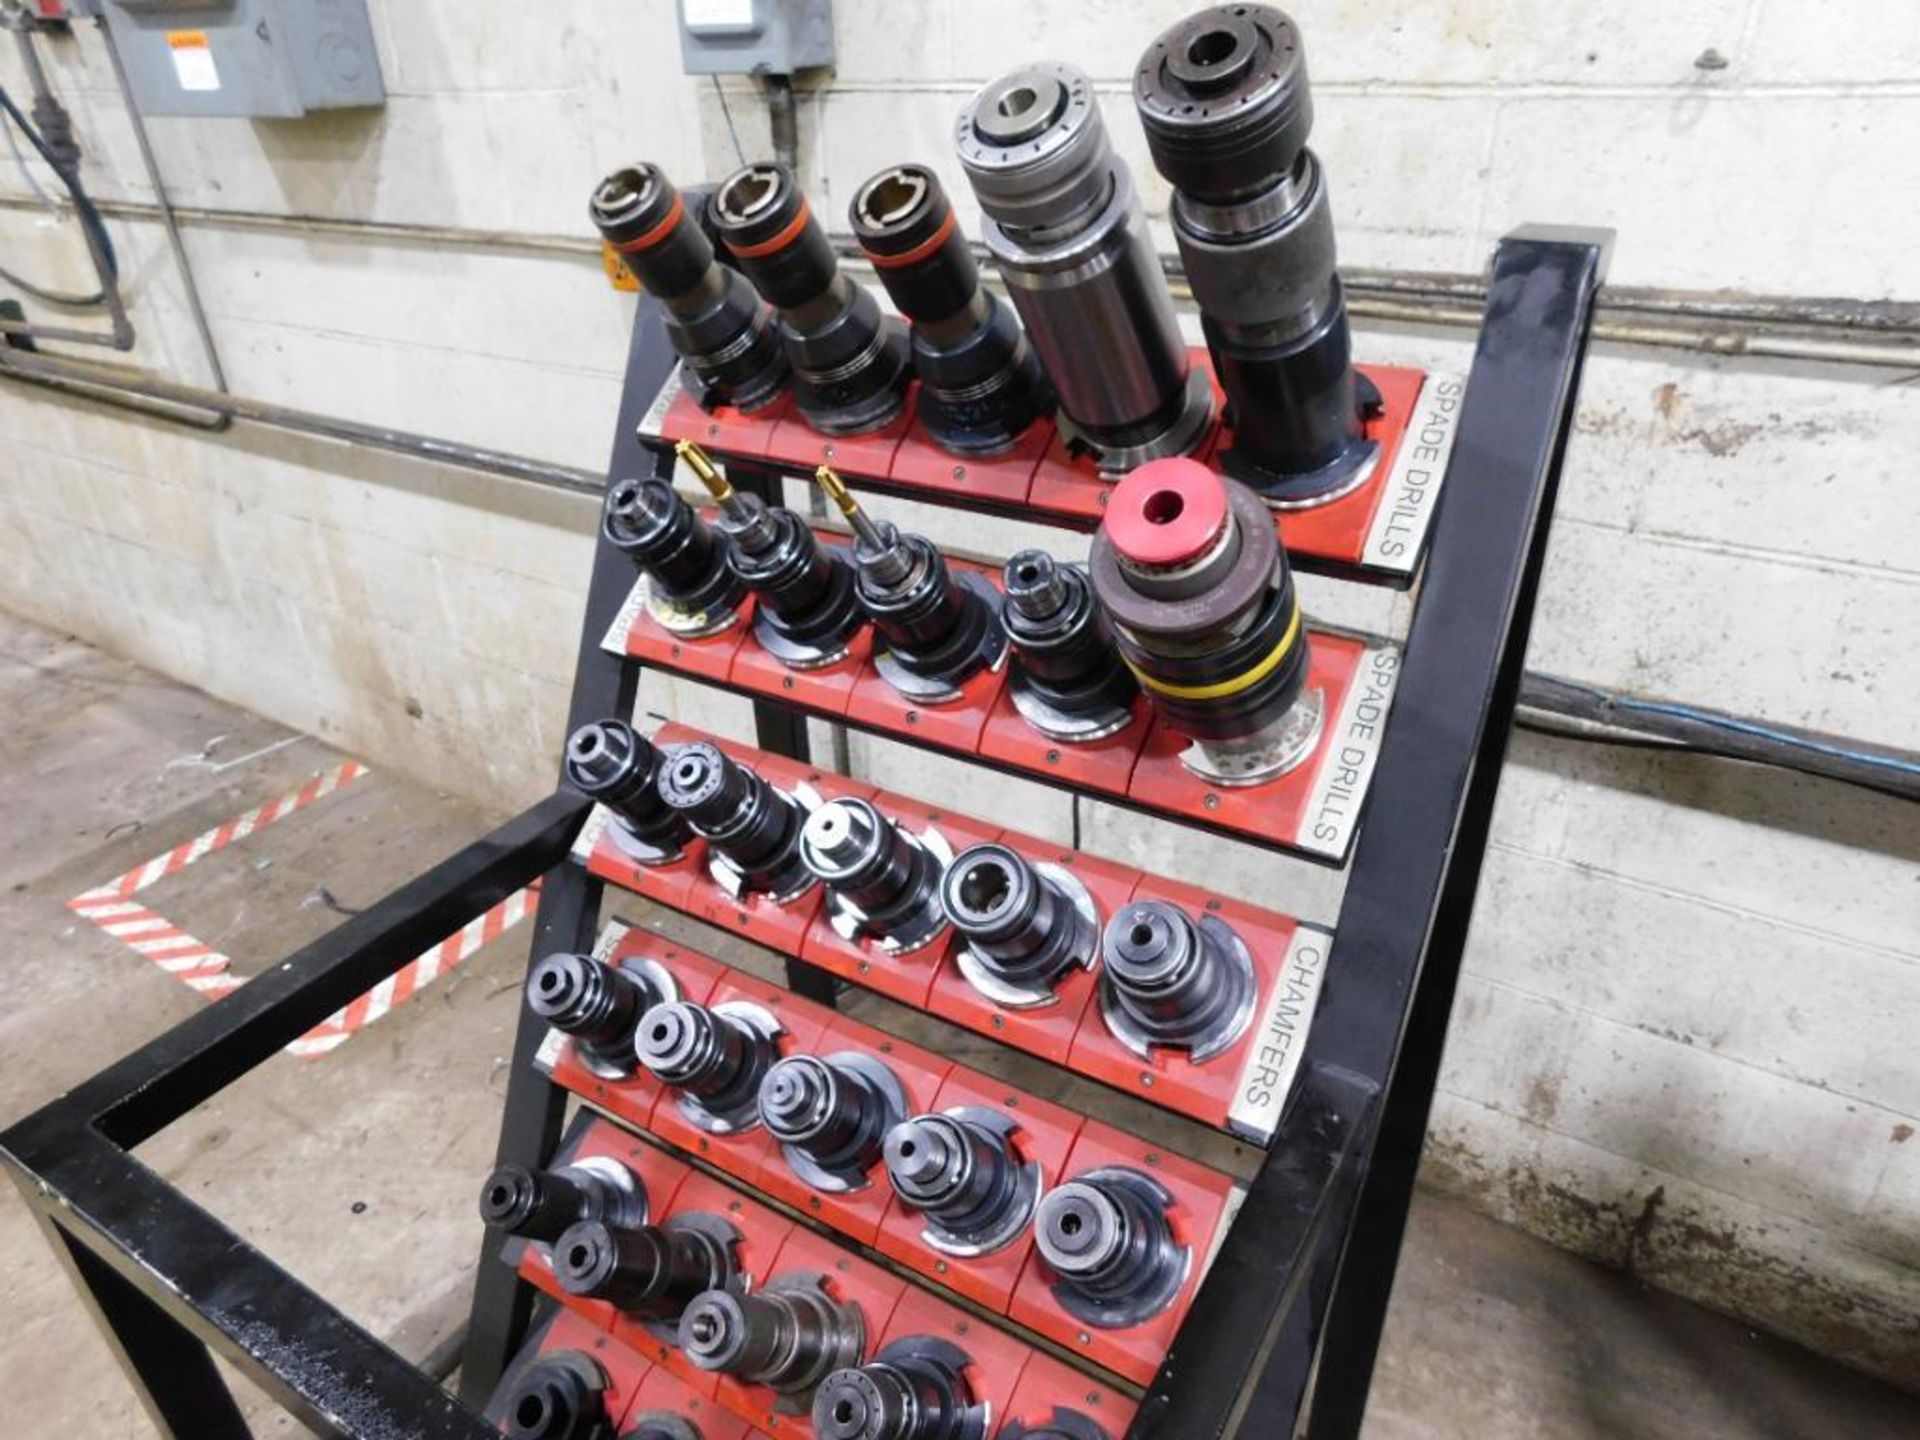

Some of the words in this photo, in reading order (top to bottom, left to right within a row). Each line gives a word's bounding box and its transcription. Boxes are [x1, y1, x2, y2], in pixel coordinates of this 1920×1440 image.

[1411, 380, 1463, 463] SPADE
[1379, 467, 1432, 558] DRILLS
[1348, 652, 1399, 742] SPADE
[1313, 746, 1366, 843] DRILLS
[1245, 945, 1320, 1109] CHAMFERS
